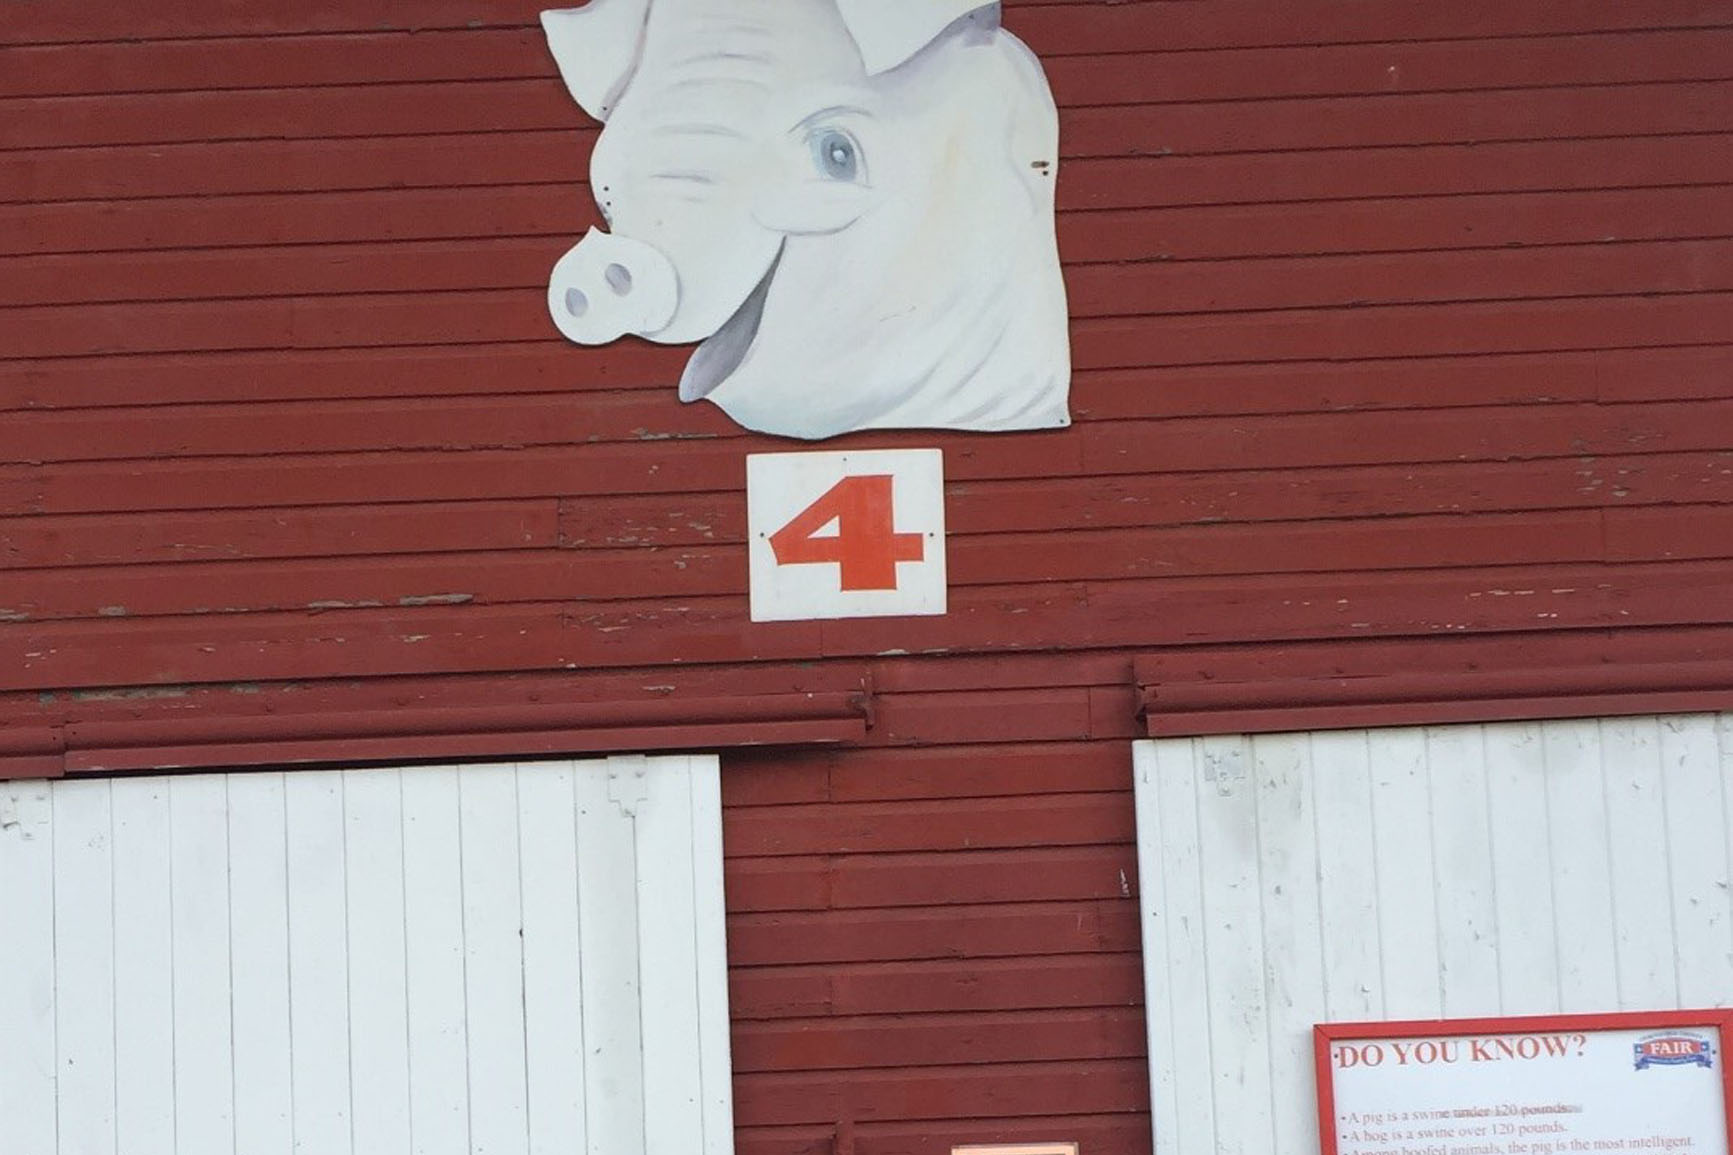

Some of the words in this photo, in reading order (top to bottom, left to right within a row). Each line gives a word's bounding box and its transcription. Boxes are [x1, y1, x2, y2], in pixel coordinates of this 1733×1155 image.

[768, 475, 924, 592] 4
[1339, 1044, 1384, 1068] DO
[1392, 1041, 1459, 1065] YOU
[1471, 1034, 1587, 1062] KNOW?
[1650, 1041, 1693, 1055] FAIR
[1350, 1112, 1359, 1124] A
[1363, 1112, 1383, 1126] pig
[1387, 1112, 1398, 1122] is
[1402, 1112, 1409, 1121] a
[1412, 1109, 1449, 1121] swine
[1453, 1106, 1490, 1118] under
[1494, 1103, 1518, 1117] 120
[1350, 1131, 1360, 1143] A
[1364, 1130, 1388, 1145] hog
[1392, 1130, 1402, 1140] is
[1406, 1130, 1414, 1139] a
[1417, 1127, 1455, 1139] swine
[1458, 1127, 1487, 1137] over
[1492, 1123, 1514, 1136] 120
[1518, 1120, 1568, 1138] pounds.
[1508, 1141, 1527, 1153] the
[1531, 1138, 1552, 1155] pig
[1556, 1139, 1566, 1150] is
[1571, 1138, 1590, 1151] the
[1594, 1138, 1624, 1150] most
